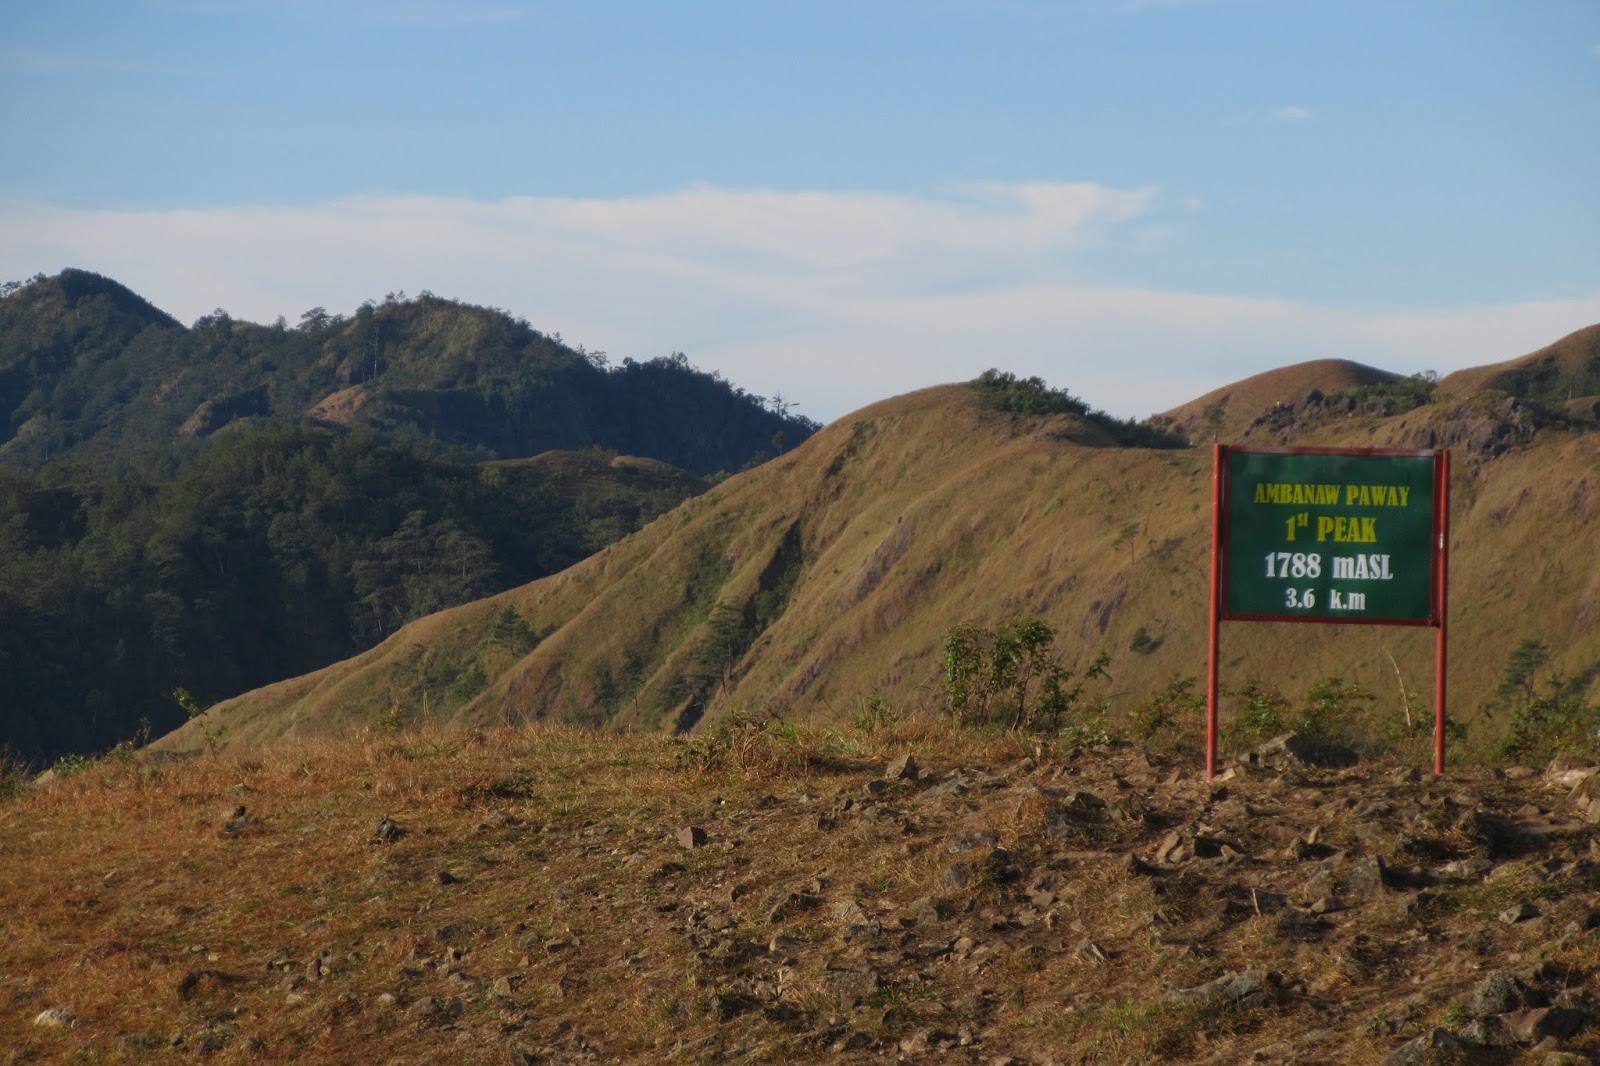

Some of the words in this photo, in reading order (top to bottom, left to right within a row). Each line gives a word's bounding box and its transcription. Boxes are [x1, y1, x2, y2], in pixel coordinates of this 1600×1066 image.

[1254, 483, 1341, 505] AMBANAW
[1346, 485, 1410, 507] PAWAY
[1317, 516, 1377, 543] PEAK
[1265, 552, 1322, 578] 1788
[1332, 554, 1393, 580] mASL
[1285, 588, 1315, 608] 3.6
